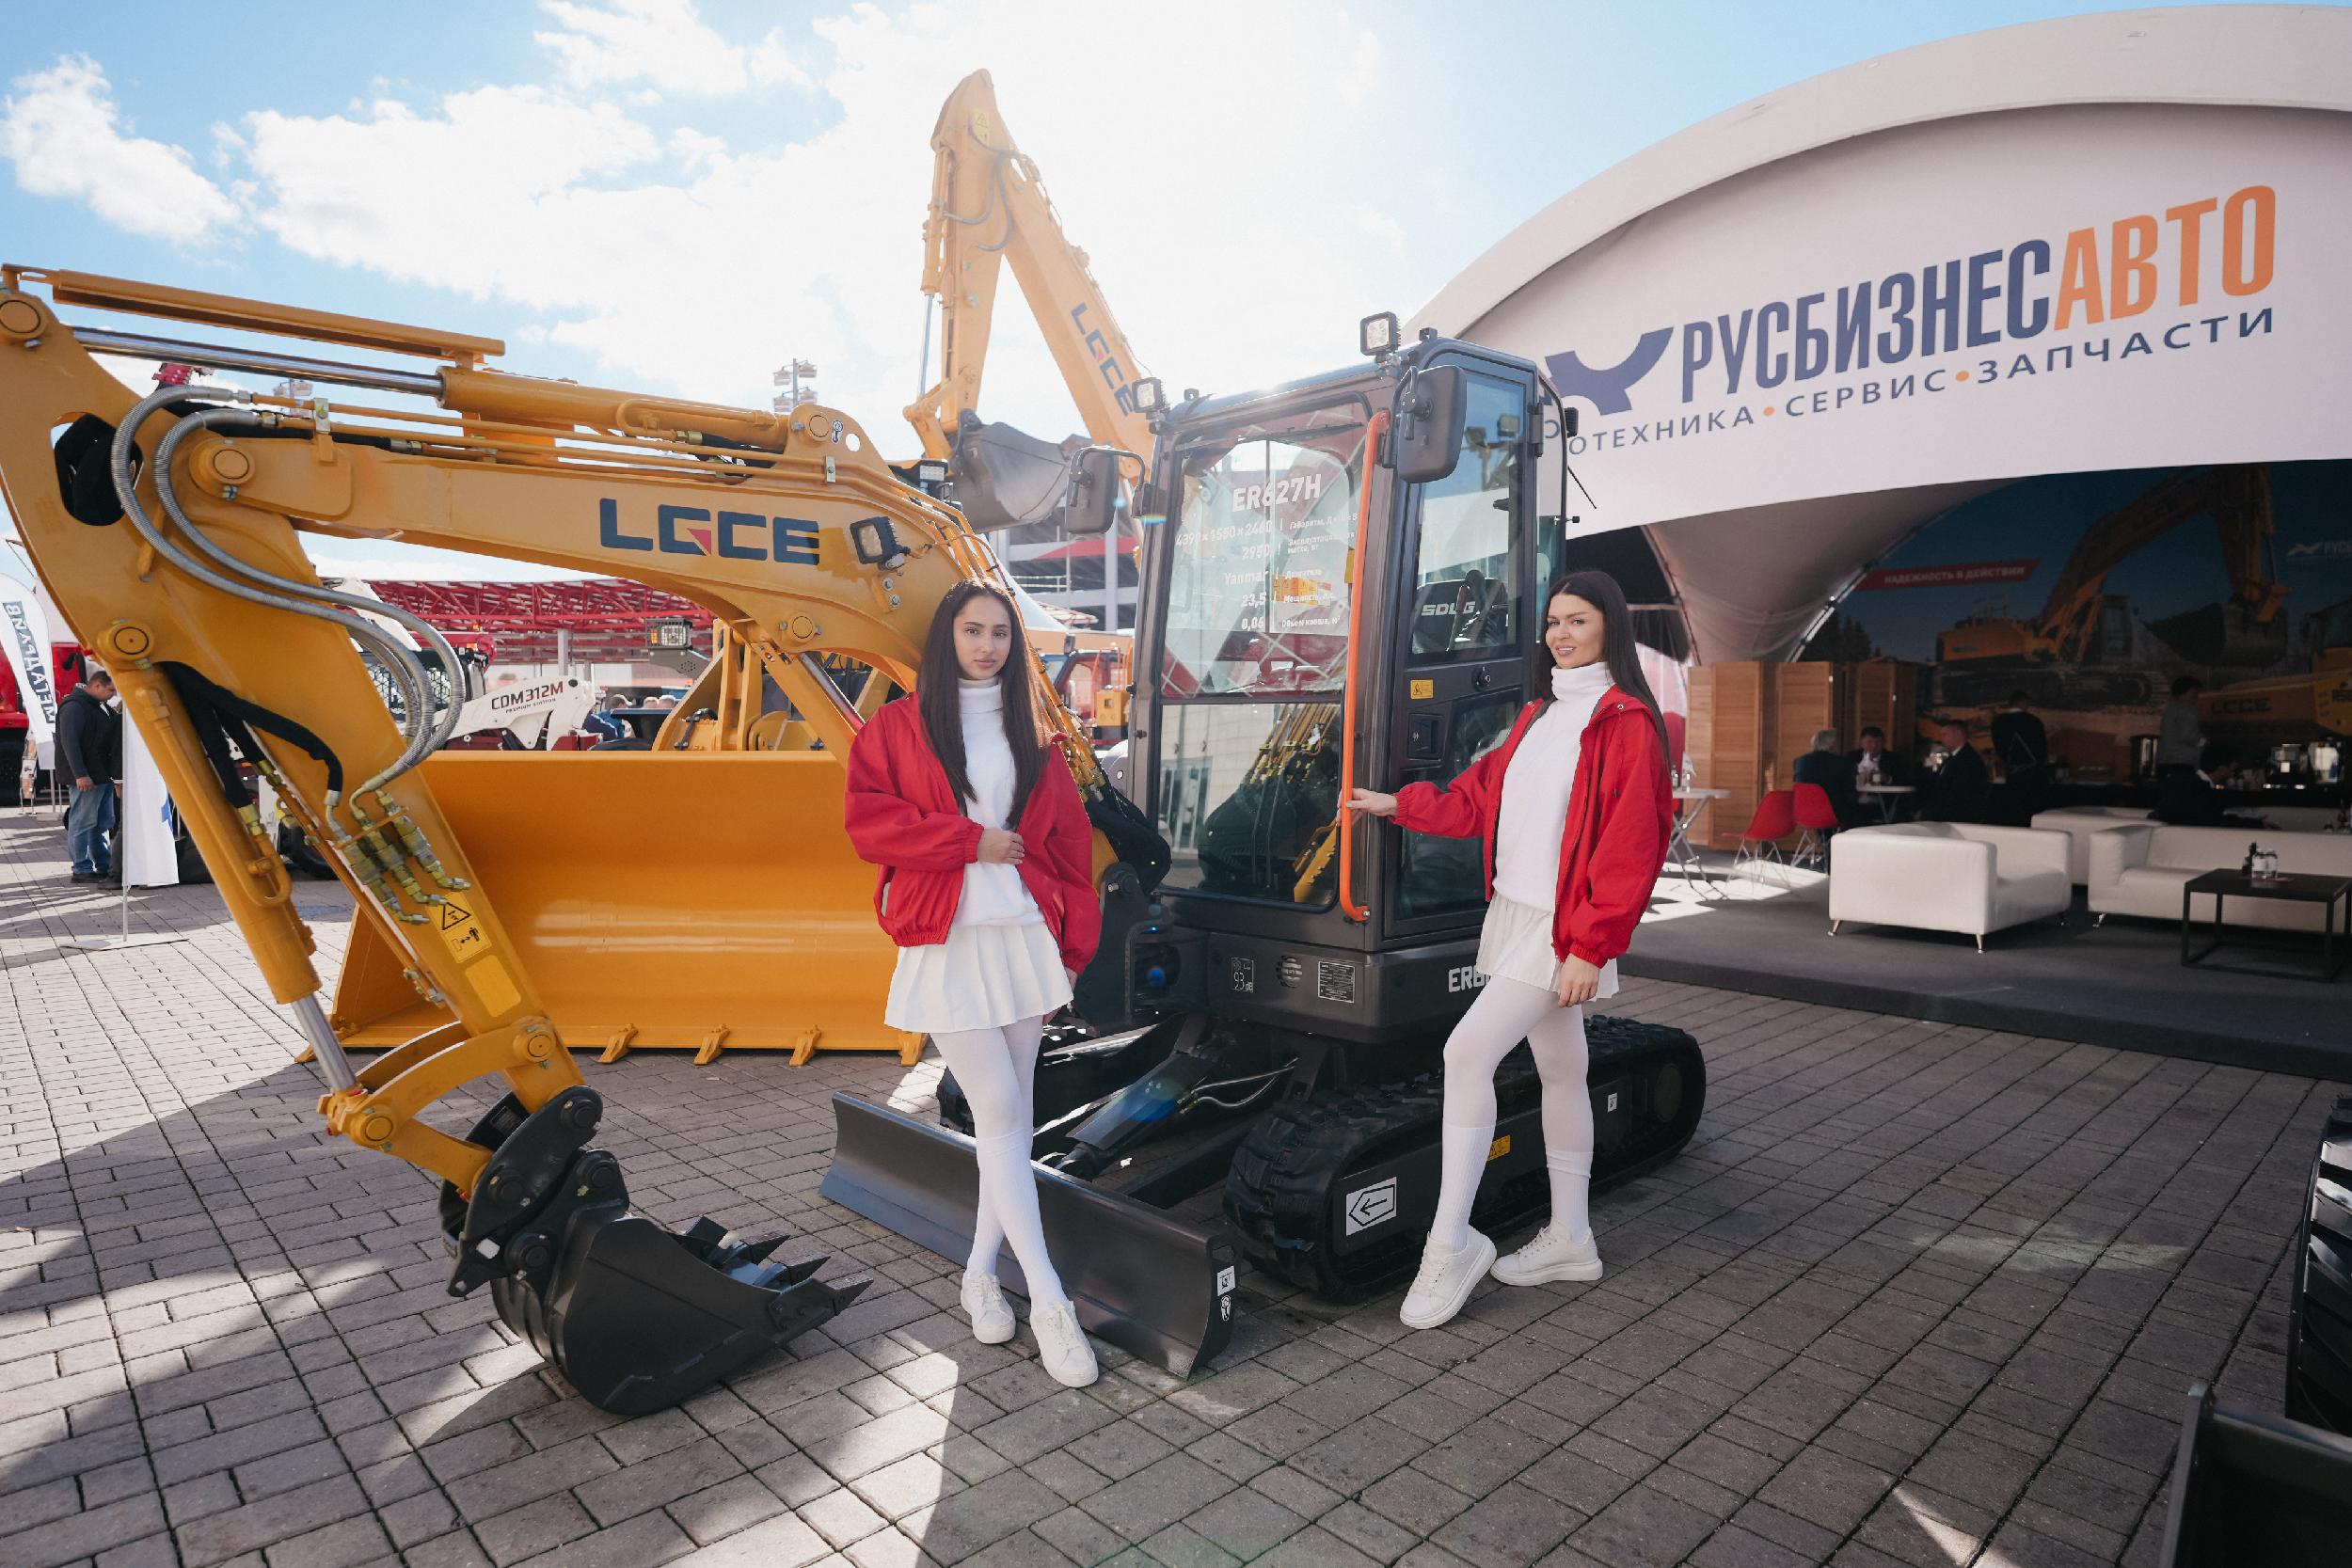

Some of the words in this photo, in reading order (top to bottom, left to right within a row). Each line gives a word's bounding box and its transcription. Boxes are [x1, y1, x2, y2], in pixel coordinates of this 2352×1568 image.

[1680, 185, 2277, 403] РУСБИЗНЕСАВТО
[1071, 302, 1134, 417] LGCE
[1786, 368, 1947, 418] СЕРВИС
[1977, 308, 2274, 385] ЗАПЧАСТИ
[1232, 473, 1322, 513] ER627H
[599, 498, 819, 565] LGCE
[1224, 570, 1269, 585] Yanmar
[1242, 616, 1265, 632] 0,06
[491, 680, 564, 710] CDM312M
